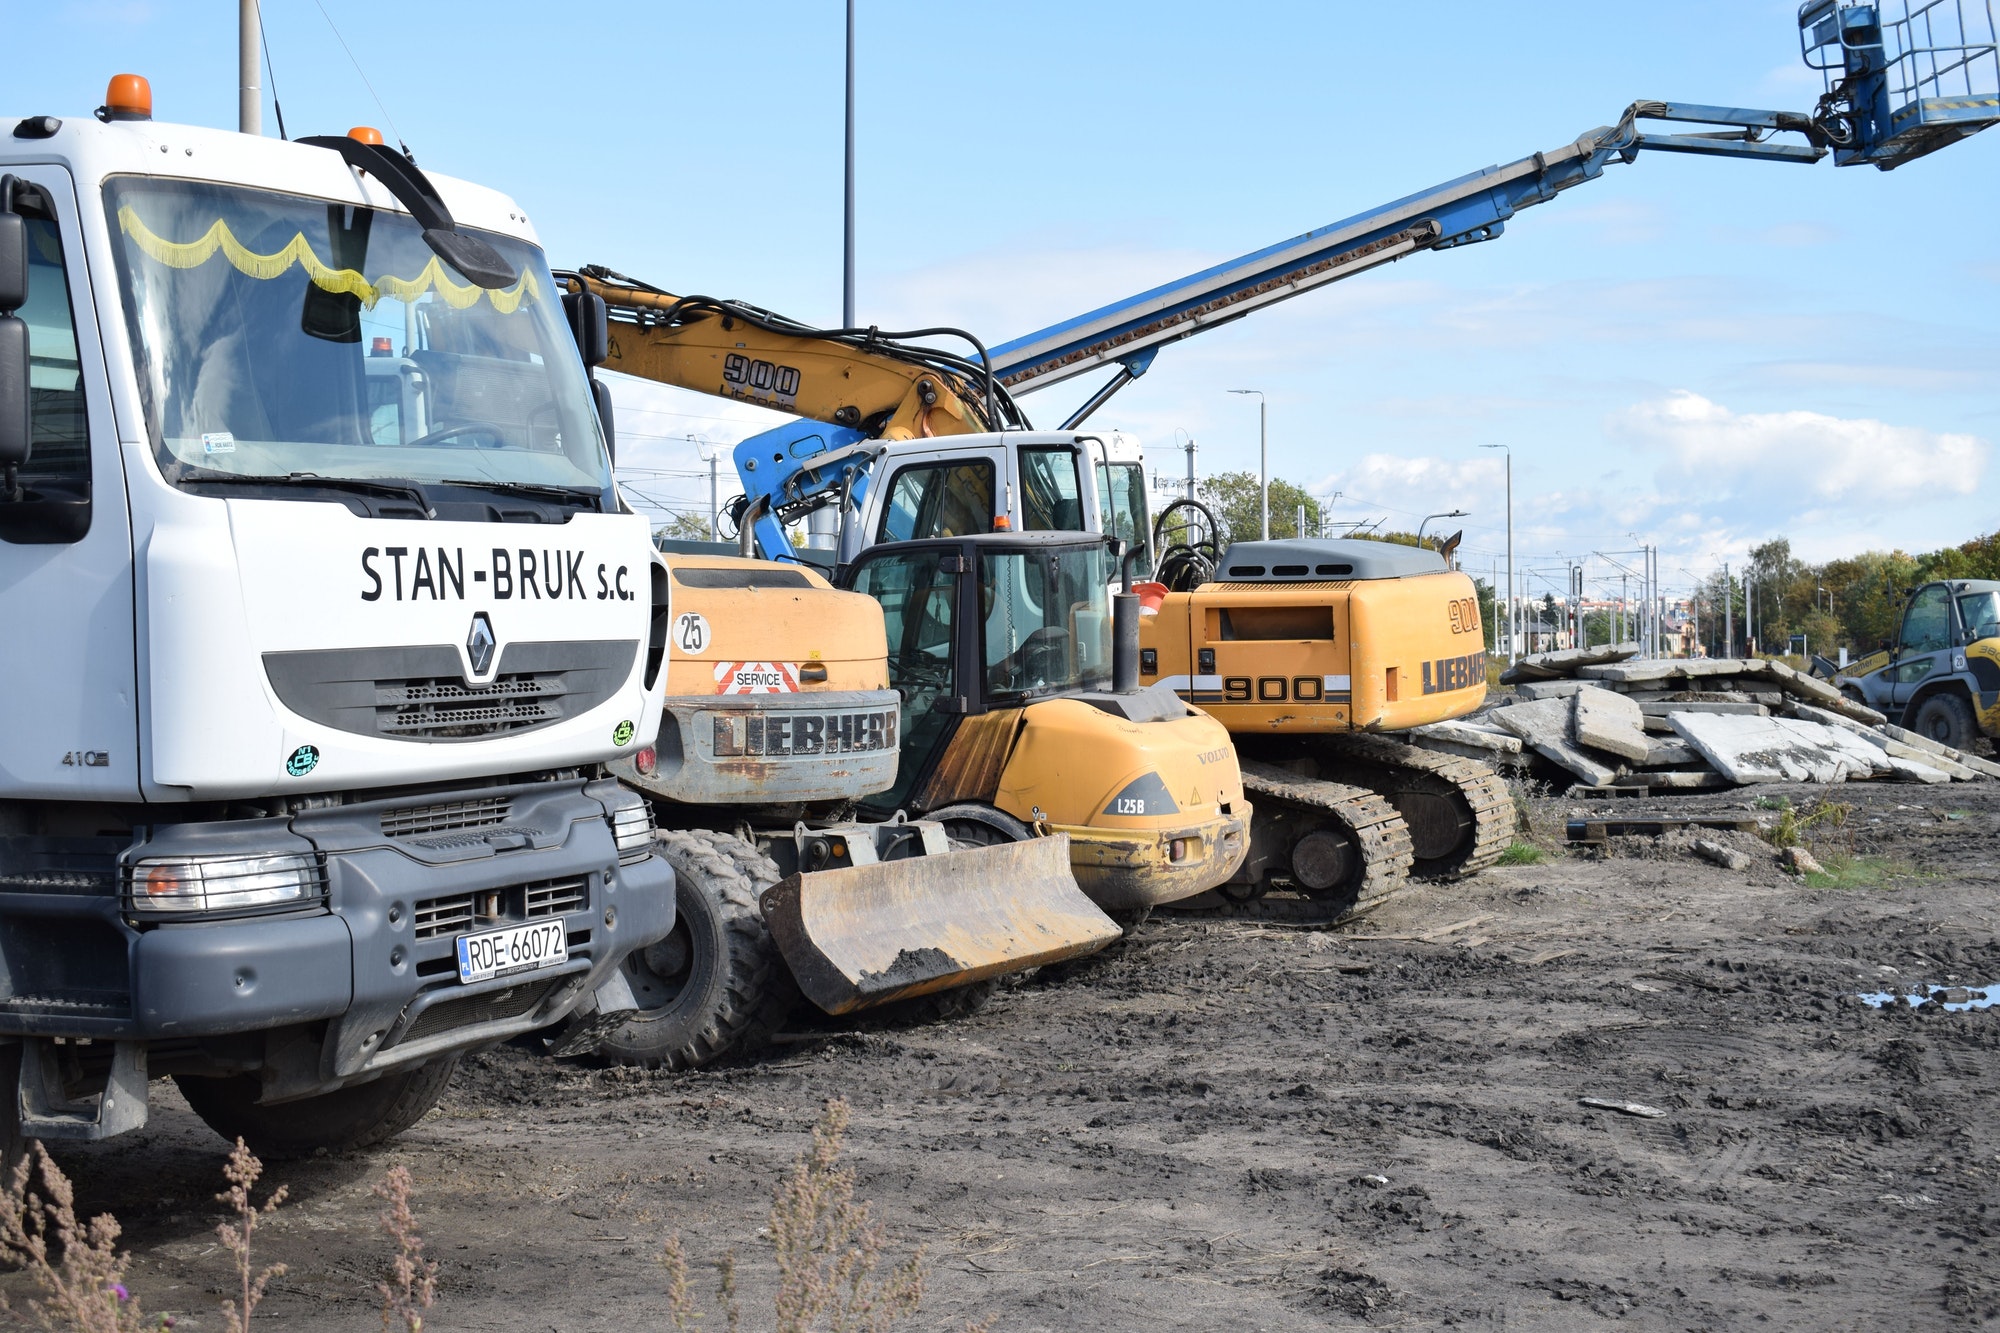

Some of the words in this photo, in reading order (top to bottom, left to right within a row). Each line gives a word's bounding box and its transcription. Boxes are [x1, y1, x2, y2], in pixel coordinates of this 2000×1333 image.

[723, 353, 801, 396] 900
[719, 384, 795, 412] Litronic
[361, 547, 587, 601] STAN-BRUK
[681, 615, 703, 650] 25
[1955, 656, 1964, 668] 20
[737, 673, 781, 686] SERVICE
[1223, 675, 1325, 702] 900
[713, 711, 897, 757] LIEBHERR
[62, 751, 96, 767] 410
[294, 752, 313, 768] CB
[1197, 746, 1230, 765] VOLVO
[1117, 798, 1145, 814] L25B
[469, 936, 506, 972] RDE
[511, 925, 563, 963] 66072
[461, 962, 470, 971] PL
